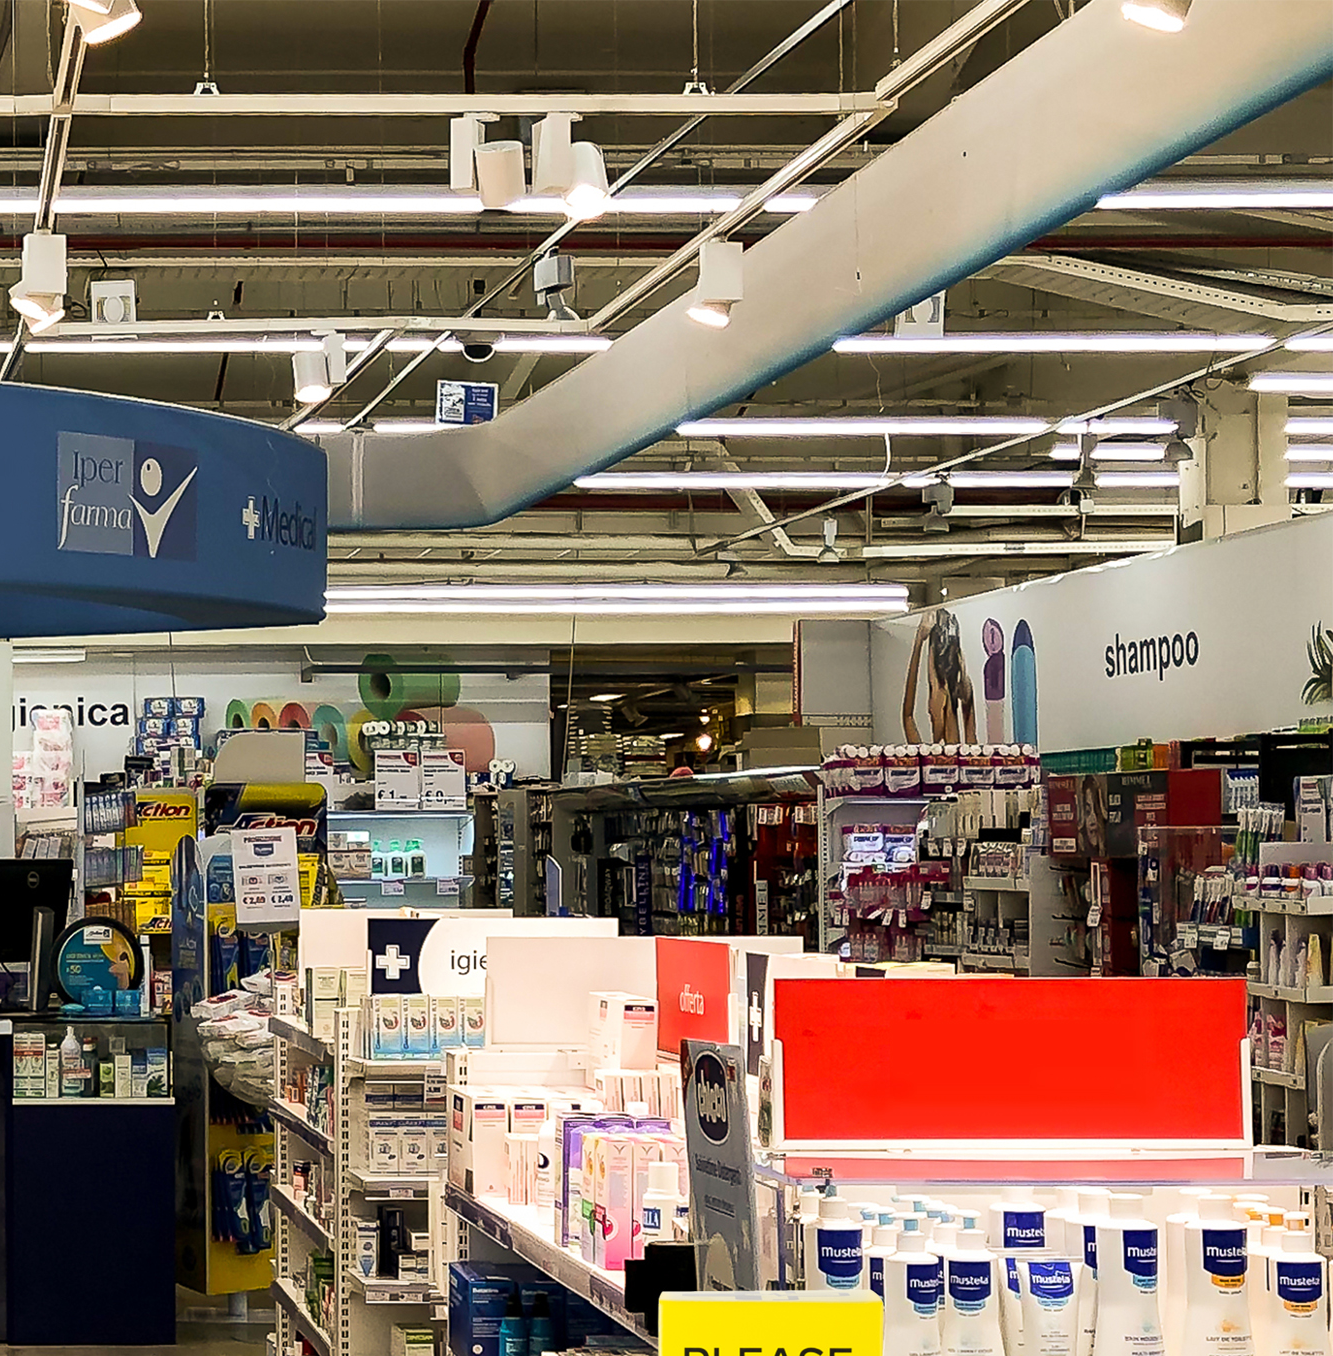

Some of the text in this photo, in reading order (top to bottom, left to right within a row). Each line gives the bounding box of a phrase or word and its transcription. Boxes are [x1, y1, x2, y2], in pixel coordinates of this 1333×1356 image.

[71, 450, 124, 488] Iper
[57, 483, 132, 550] farma
[260, 497, 317, 551] Medical
[1105, 628, 1200, 681] shampoo
[678, 982, 704, 1016] offerta
[950, 1275, 989, 1285] Mustela
[1032, 1274, 1070, 1284] Mustela
[1279, 1275, 1320, 1286] Mustela
